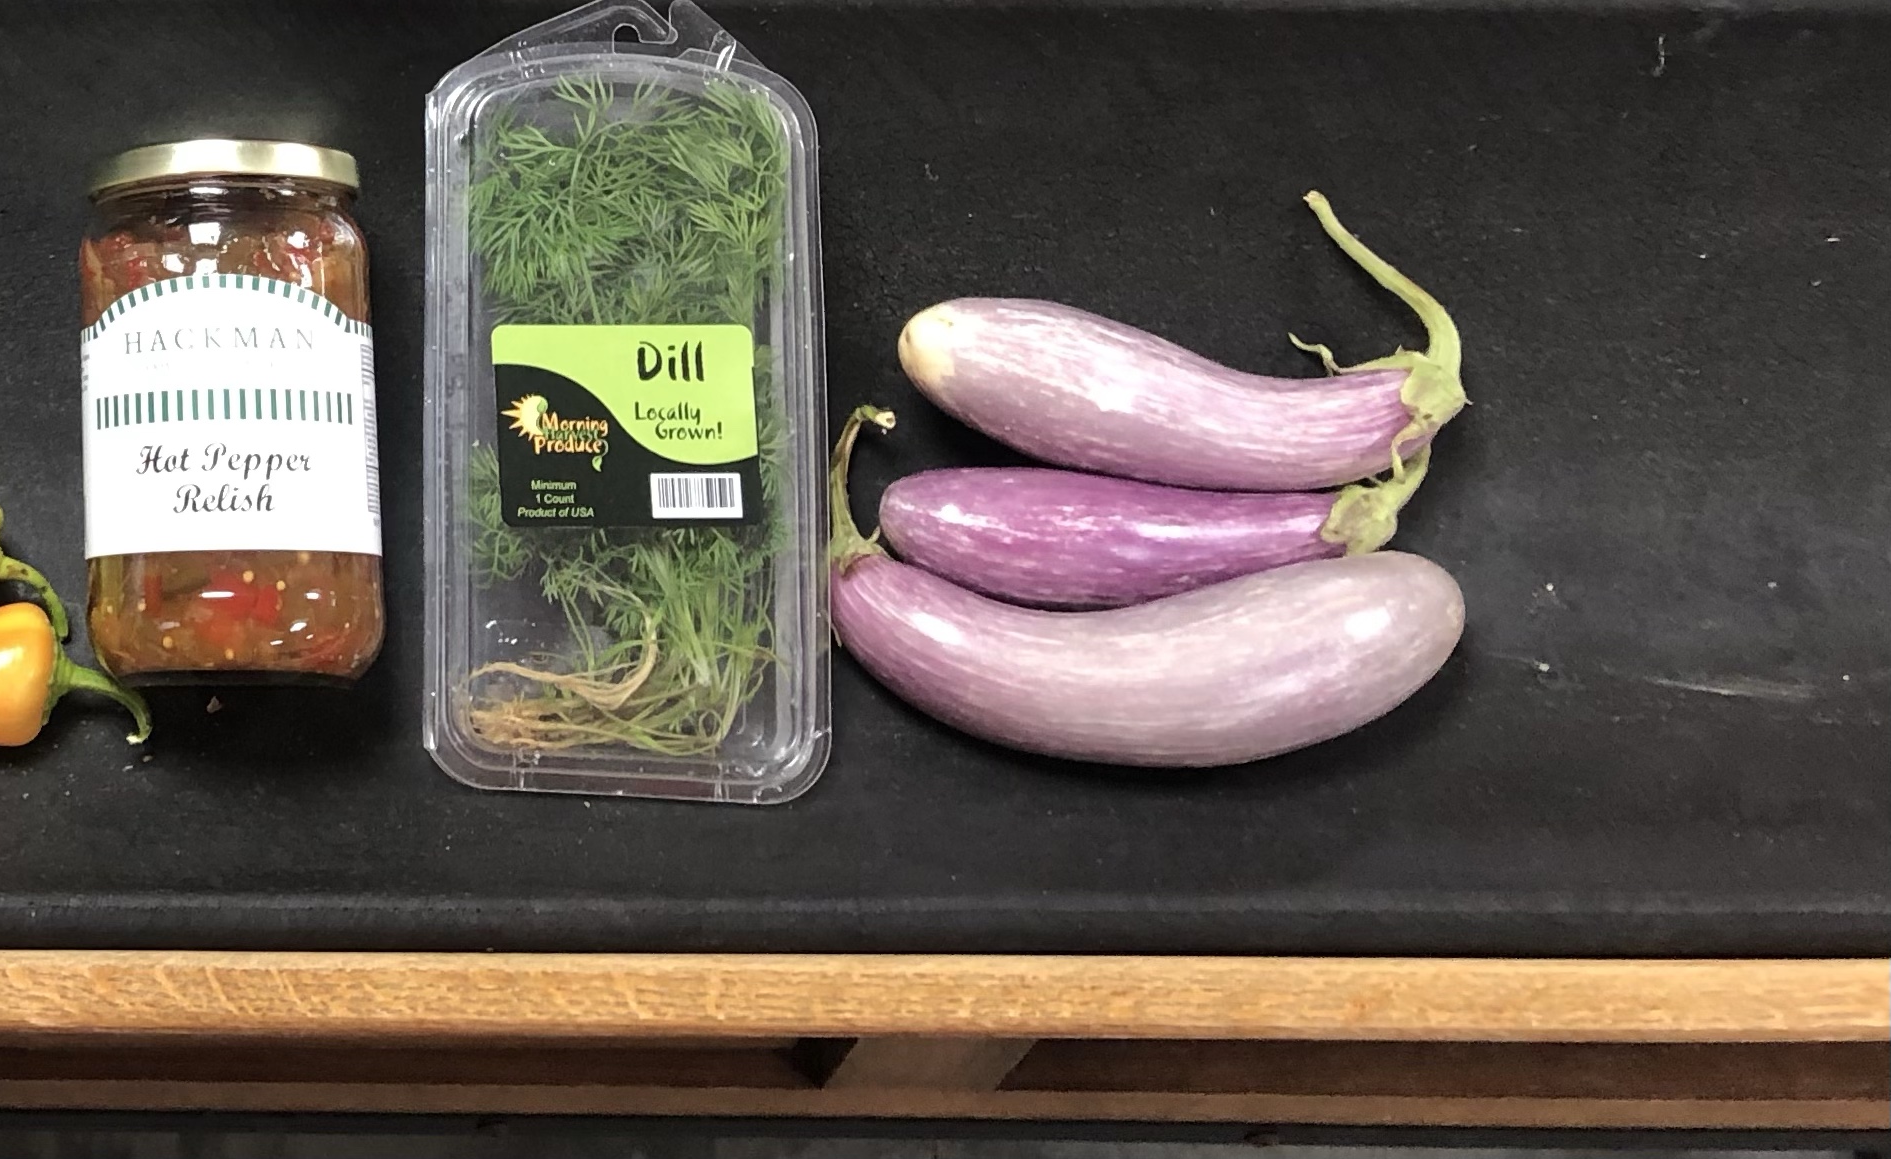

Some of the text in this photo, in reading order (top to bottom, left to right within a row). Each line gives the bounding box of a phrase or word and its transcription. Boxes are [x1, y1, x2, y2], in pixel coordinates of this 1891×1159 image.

[124, 327, 313, 354] HACKMAN
[637, 341, 705, 382] Dill
[542, 411, 608, 437] Morning
[634, 402, 700, 426] Locally
[544, 427, 599, 440] Harvest
[655, 422, 723, 440] Grown!
[534, 435, 602, 455] Produce
[136, 443, 311, 480] Hot Pepper
[531, 480, 576, 490] Minimum
[173, 483, 275, 514] Relish
[544, 493, 575, 504] Count
[517, 507, 594, 518] Product of USA
